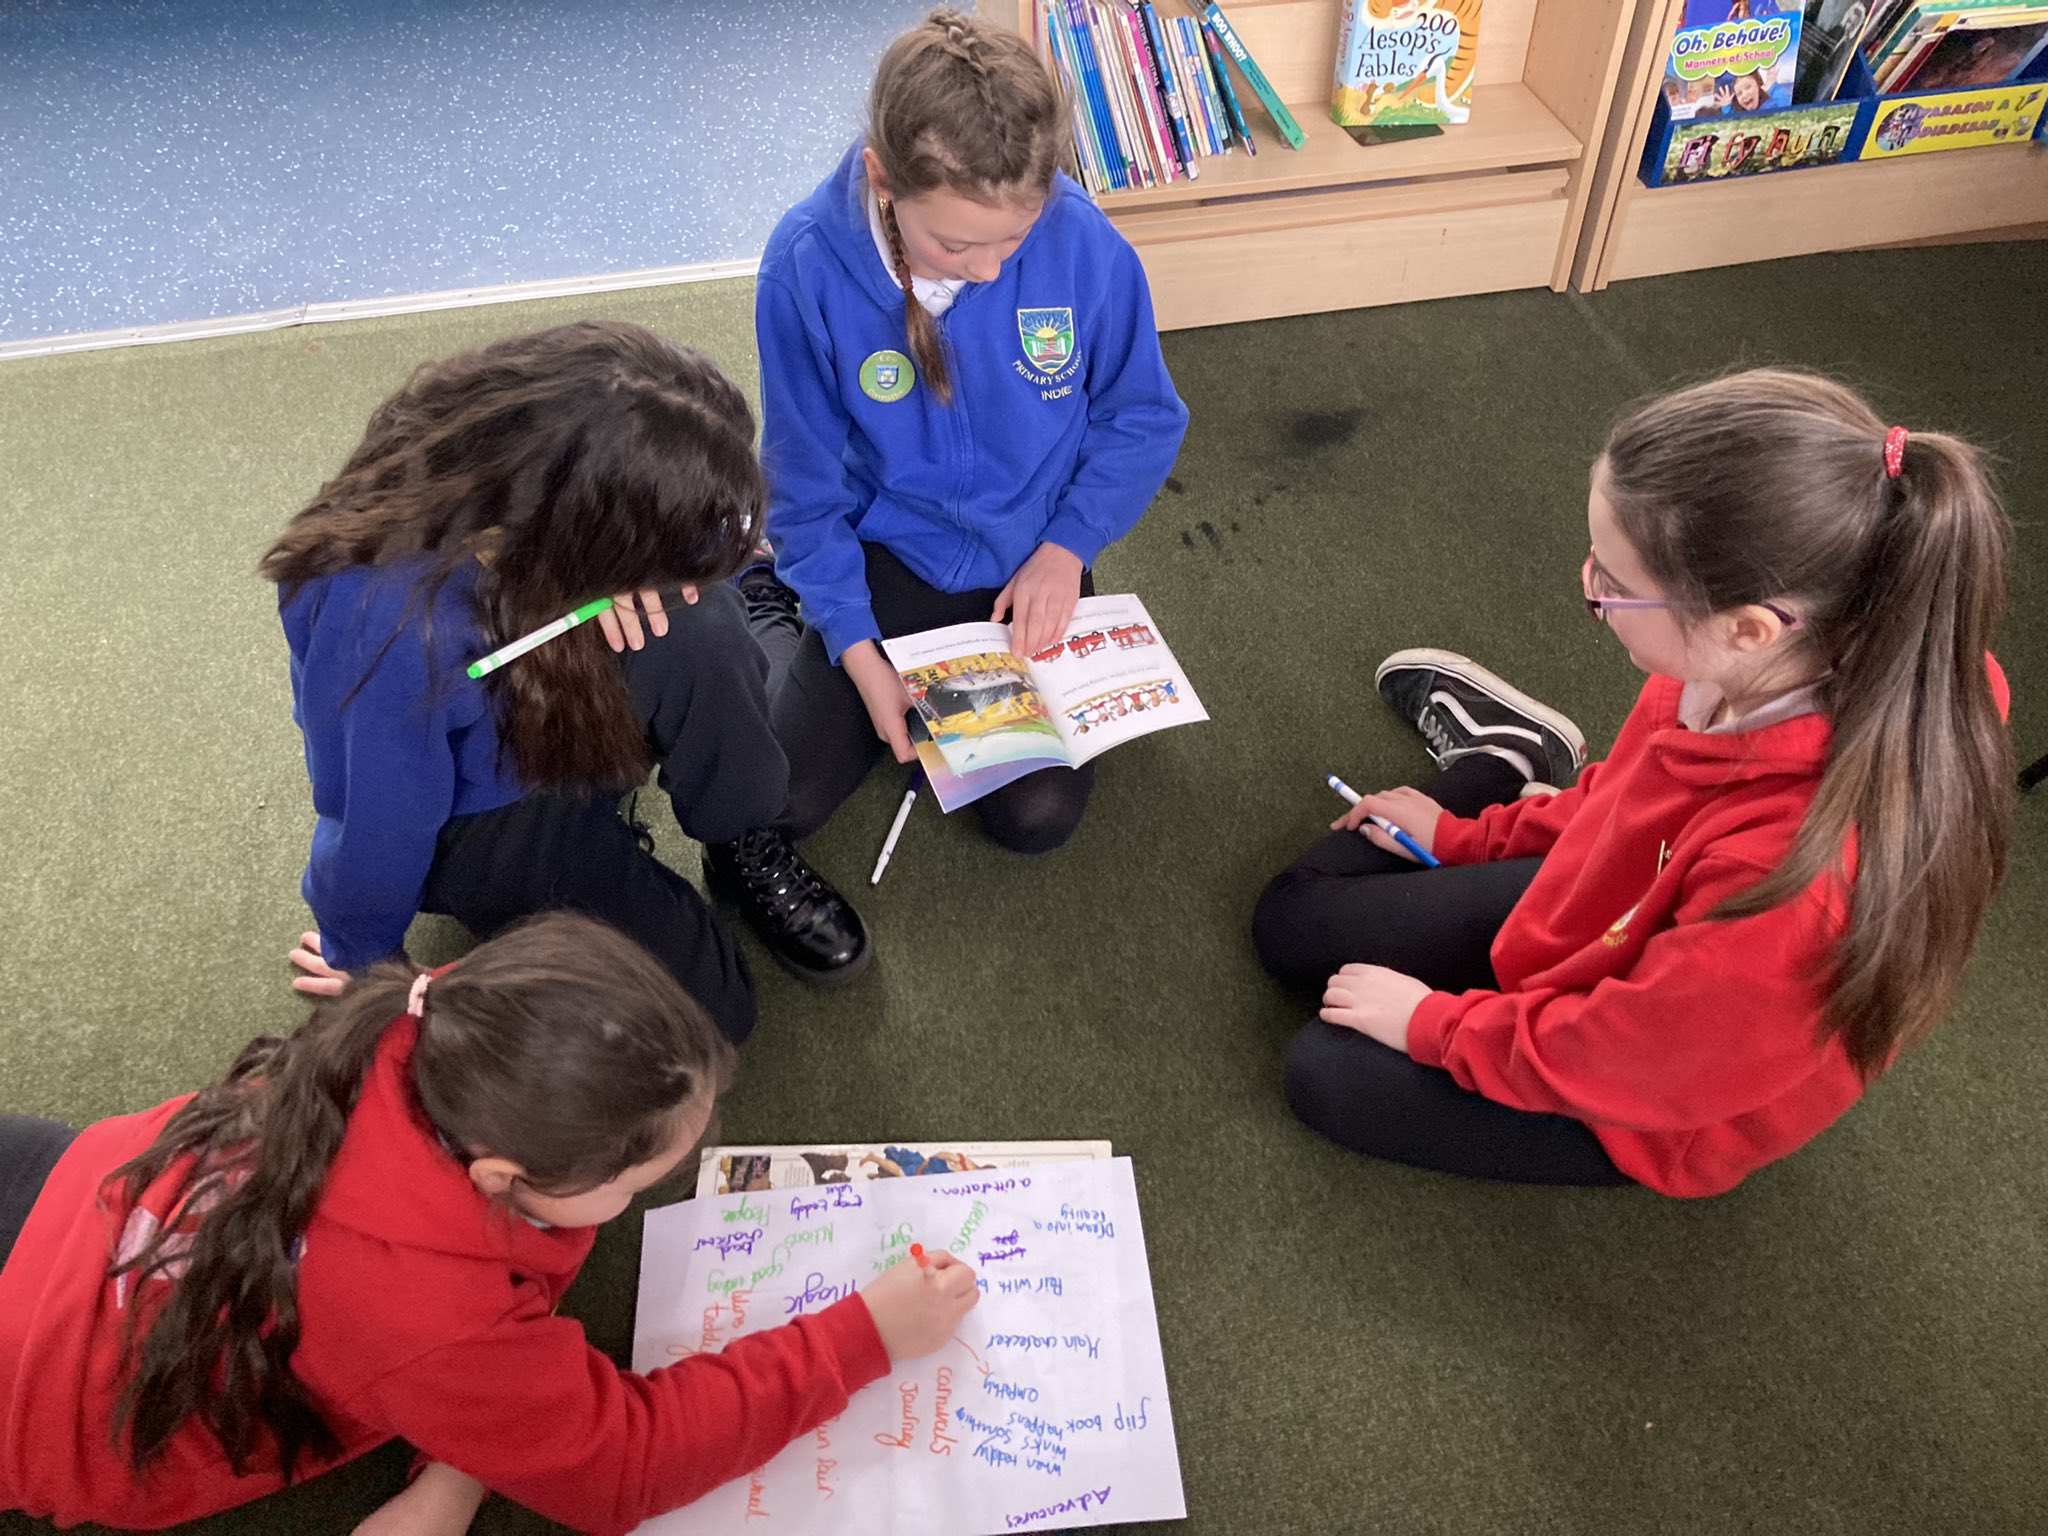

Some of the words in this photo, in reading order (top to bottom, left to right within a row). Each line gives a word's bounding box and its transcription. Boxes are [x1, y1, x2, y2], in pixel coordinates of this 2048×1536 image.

[1211, 12, 1227, 33] BOO
[1224, 30, 1247, 62] WHOO?
[1416, 13, 1457, 35] 200
[1358, 26, 1441, 56] Aesop's
[1675, 36, 1708, 56] Oh,
[1713, 21, 1789, 50] Behave!
[1145, 45, 1160, 86] CHRISTMAS
[1355, 50, 1418, 78] Fables
[1684, 57, 1727, 71] Manners
[1728, 55, 1741, 64] at
[1744, 49, 1775, 62] School
[1012, 359, 1053, 385] PRIMARY
[1041, 385, 1072, 401] INDIE
[1033, 1219, 1042, 1230] a
[1075, 1222, 1115, 1239] Dream
[998, 1278, 1032, 1293] with
[1062, 1334, 1100, 1360] Main
[1006, 1411, 1063, 1441] happens
[1066, 1414, 1102, 1434] book
